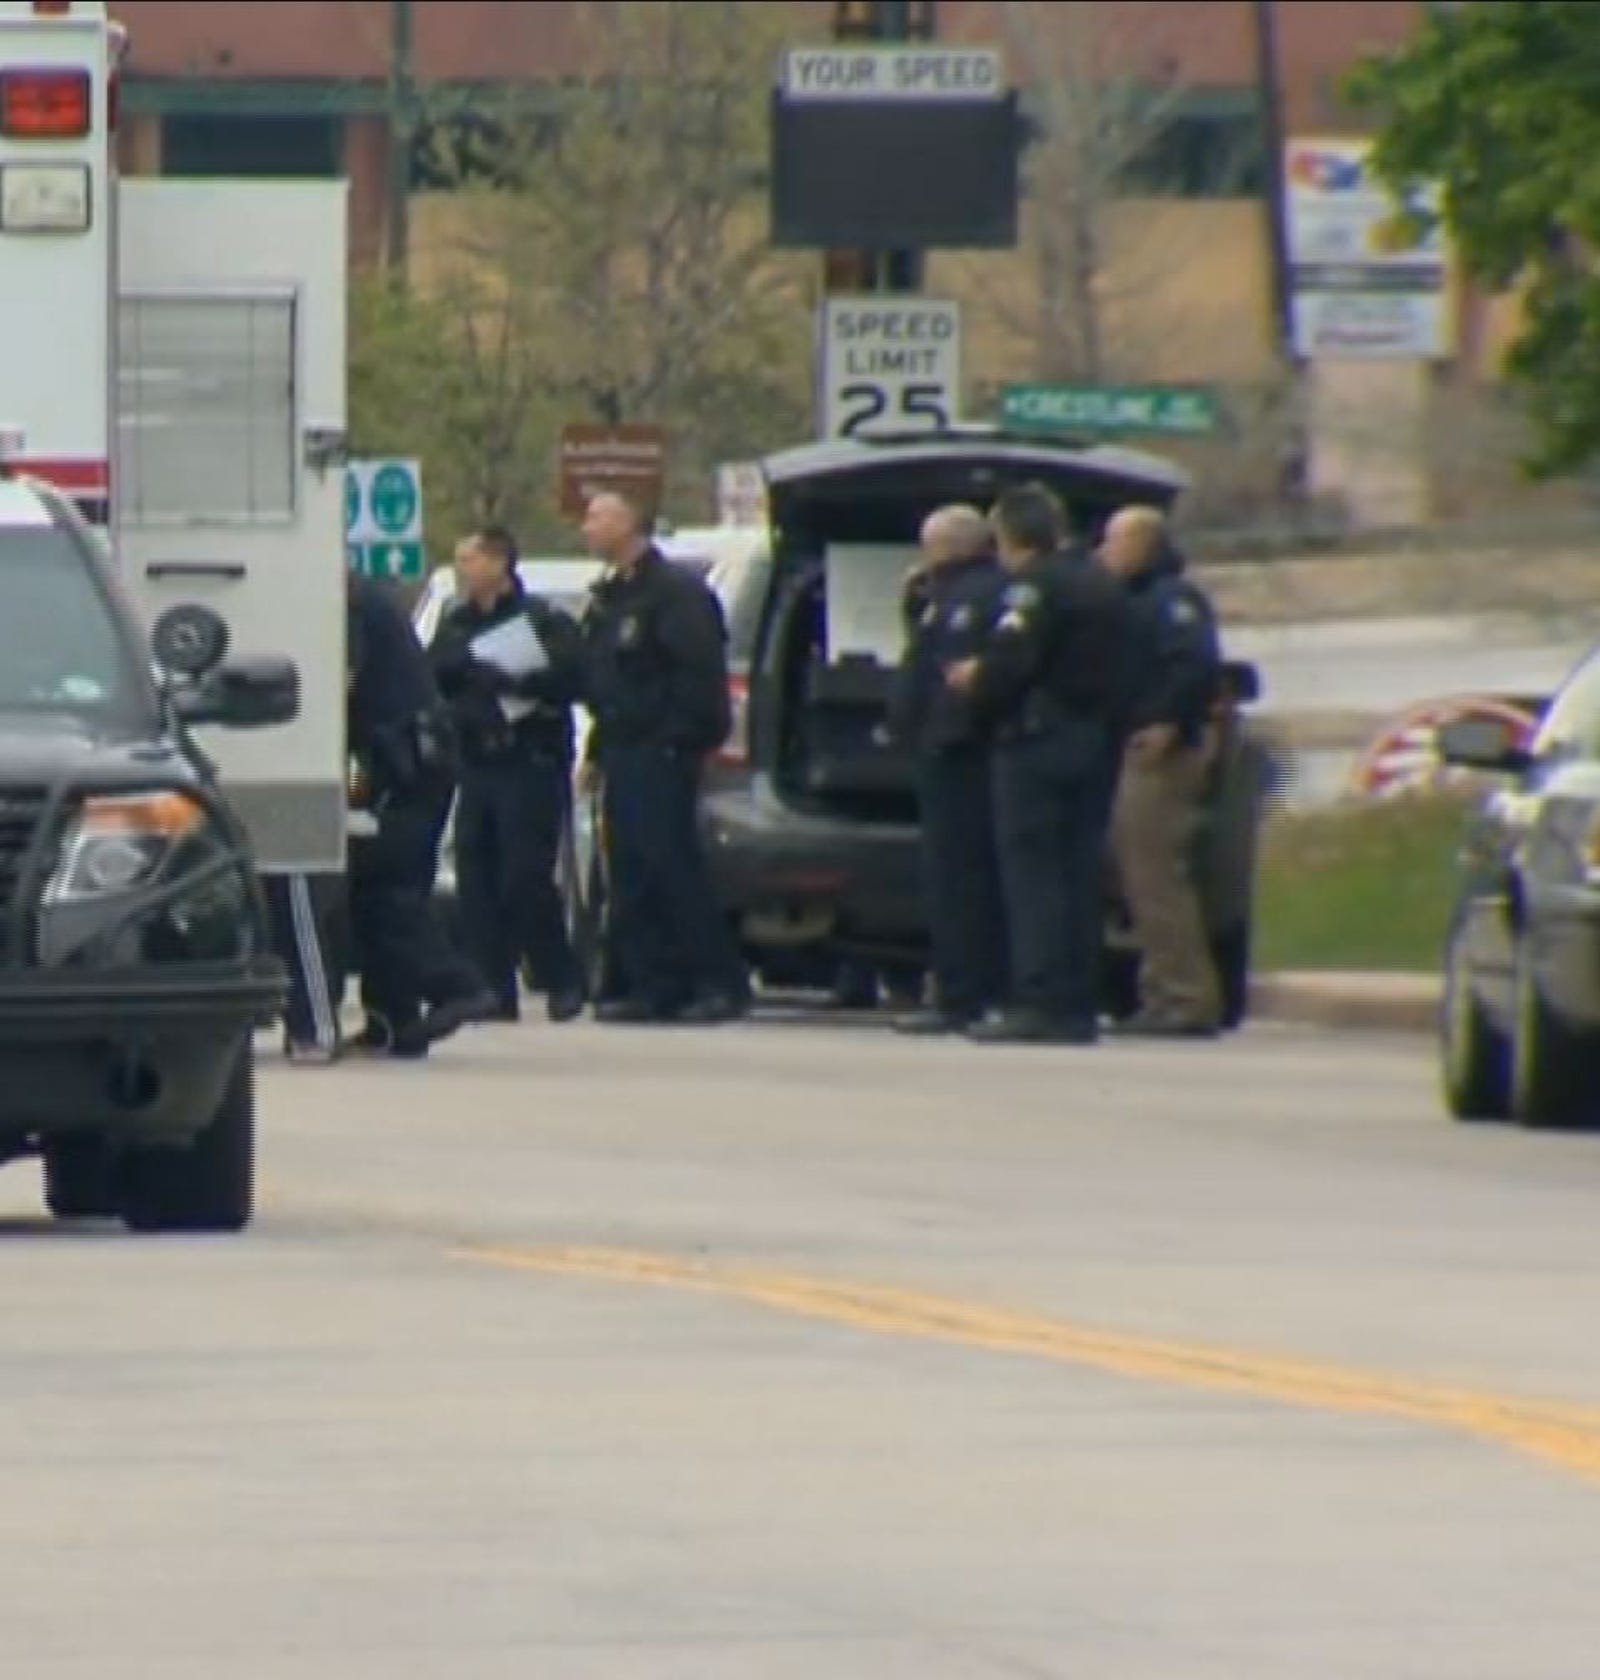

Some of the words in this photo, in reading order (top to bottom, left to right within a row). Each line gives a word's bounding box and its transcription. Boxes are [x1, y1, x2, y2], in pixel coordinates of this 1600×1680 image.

[797, 56, 874, 87] YOUR
[895, 56, 992, 87] SPEED
[836, 312, 953, 340] SPEED
[844, 348, 937, 374] LIMIT
[839, 385, 948, 436] 25
